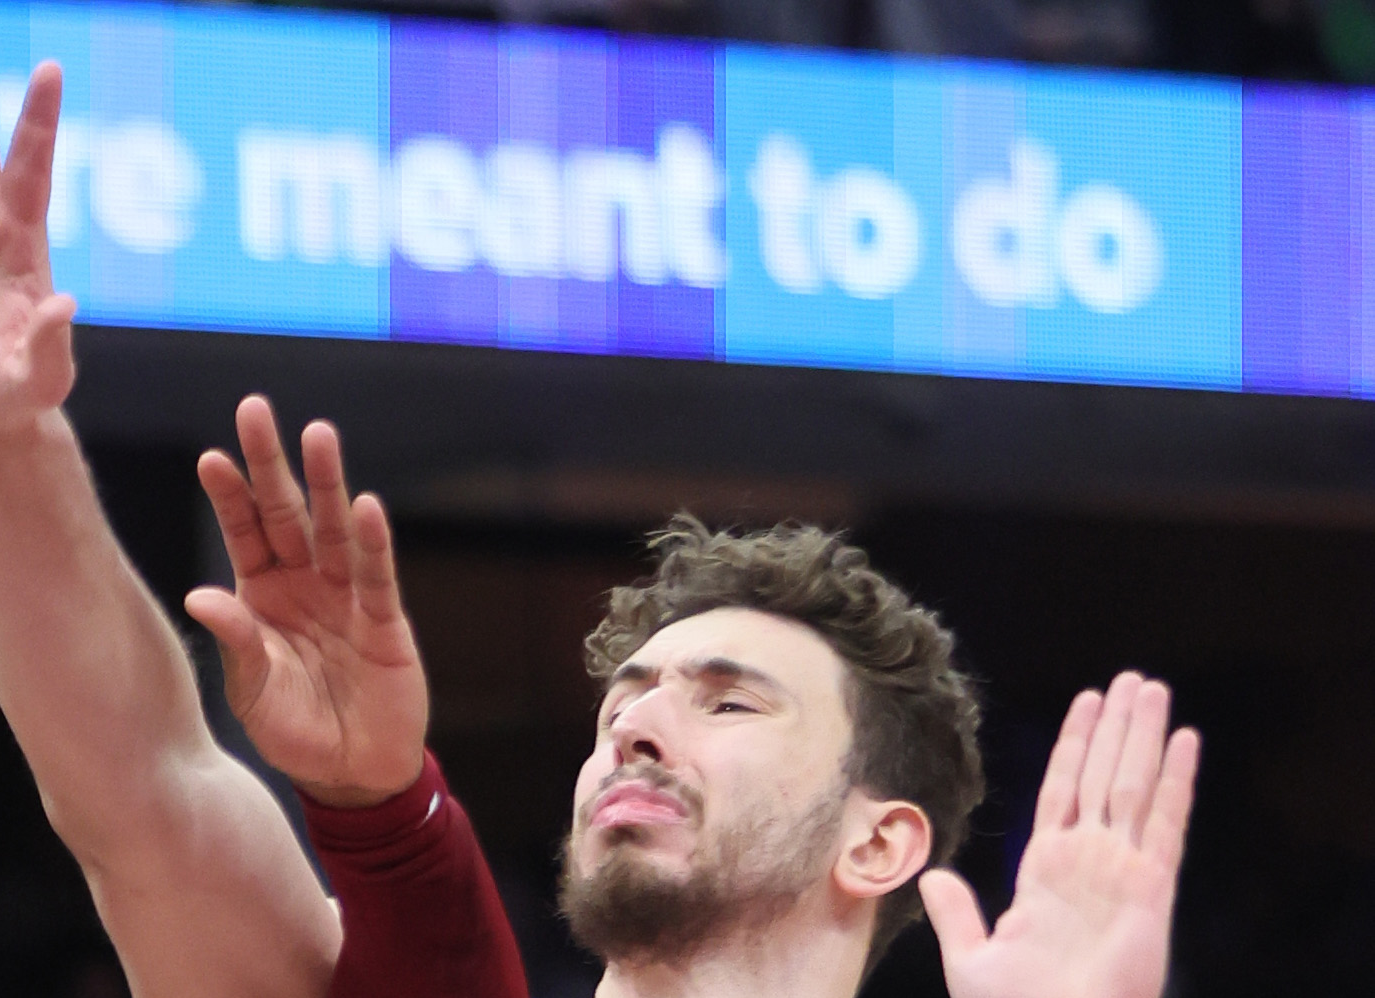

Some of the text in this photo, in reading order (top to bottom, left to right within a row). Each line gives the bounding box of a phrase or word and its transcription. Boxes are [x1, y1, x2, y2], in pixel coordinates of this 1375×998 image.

[238, 121, 726, 289] meant
[749, 133, 921, 300] to
[952, 136, 1163, 315] do
